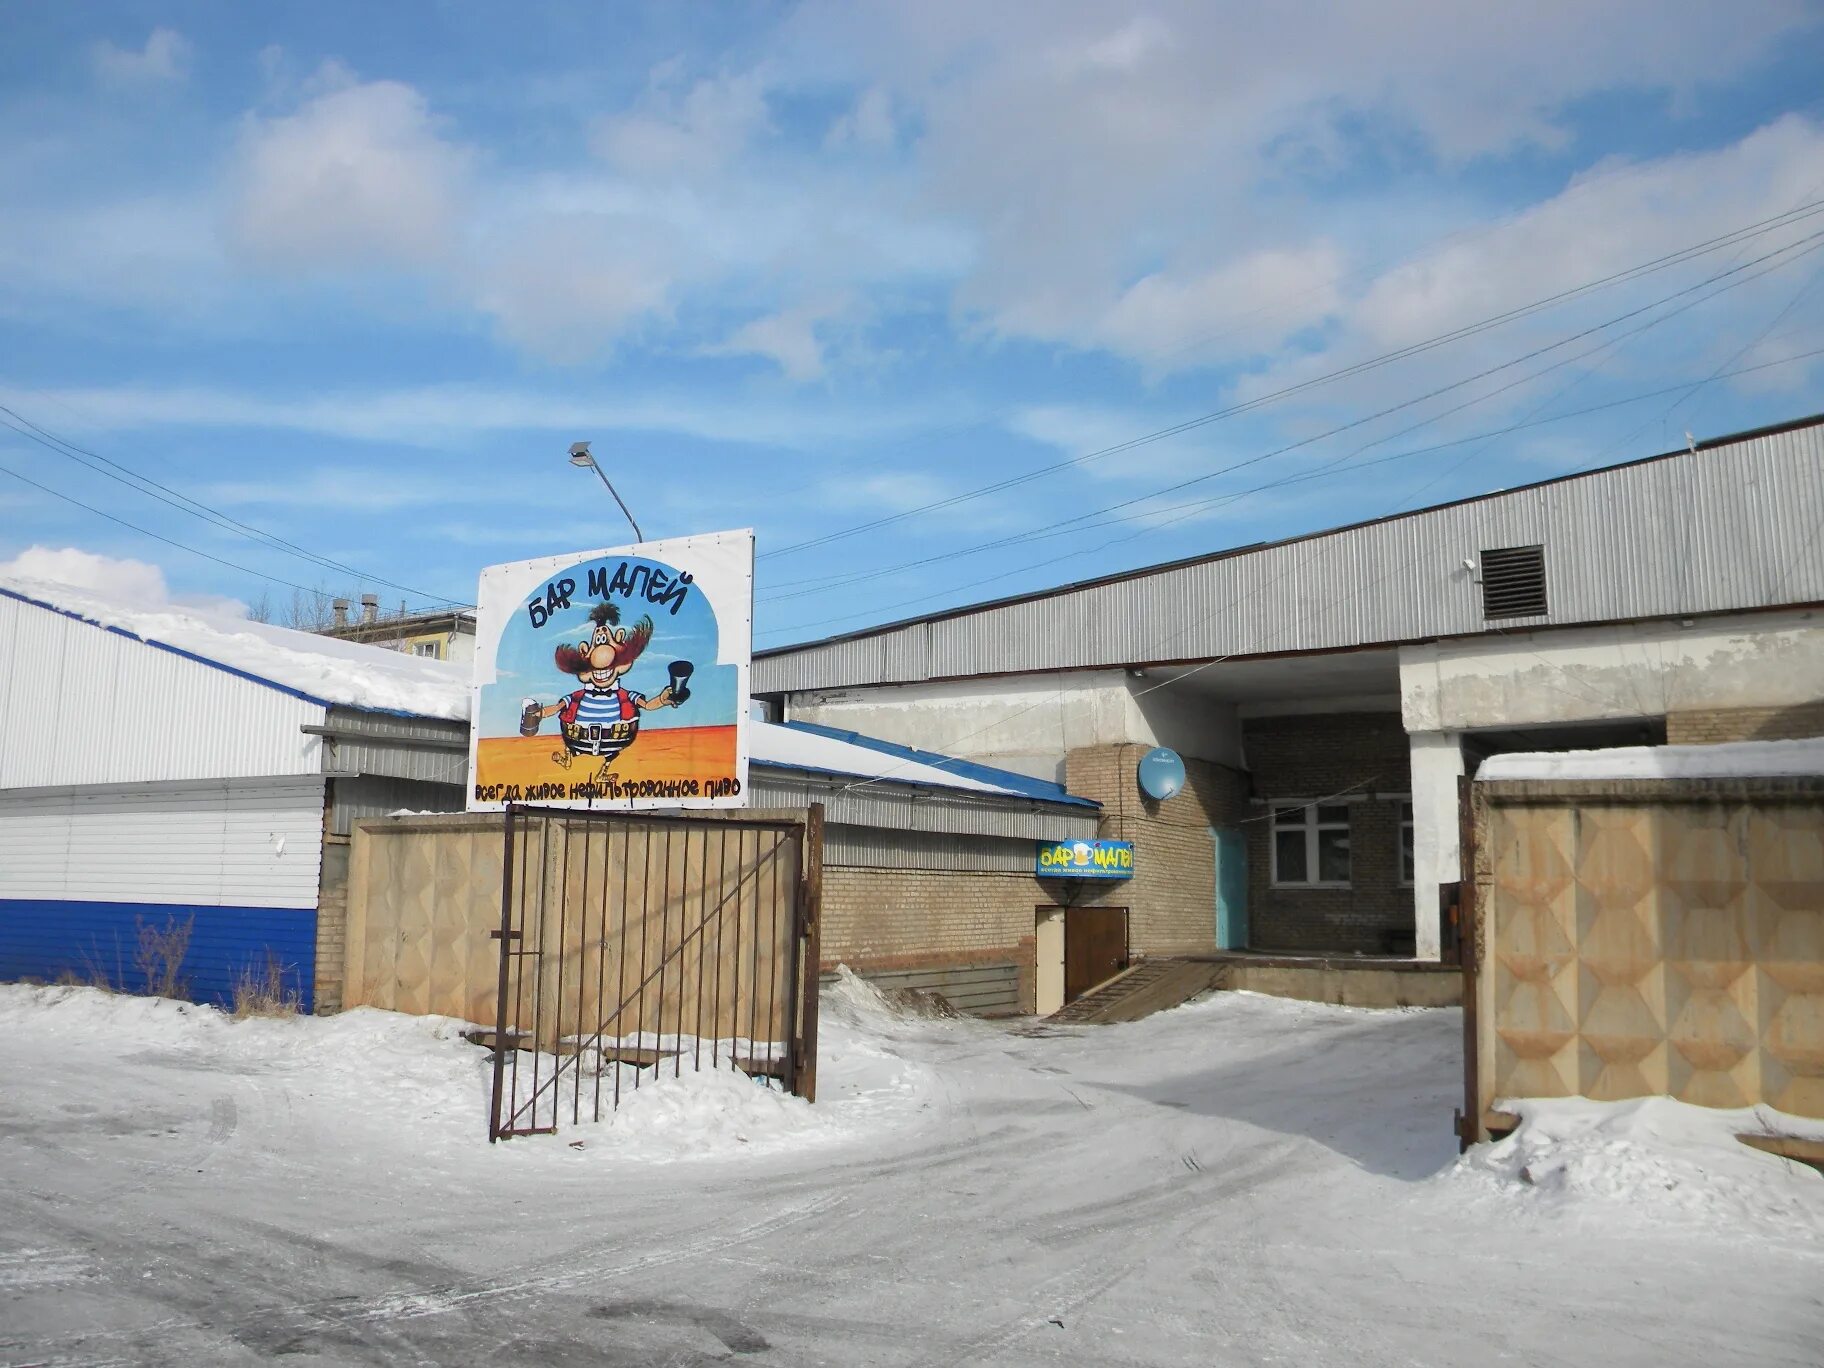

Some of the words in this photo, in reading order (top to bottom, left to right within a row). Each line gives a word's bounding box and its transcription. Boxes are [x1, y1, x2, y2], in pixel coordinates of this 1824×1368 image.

[528, 578, 576, 629] БАР
[525, 782, 565, 801] живое
[569, 772, 699, 808] нефильтрованное
[705, 777, 741, 800] пиво
[1041, 846, 1074, 867] БАР
